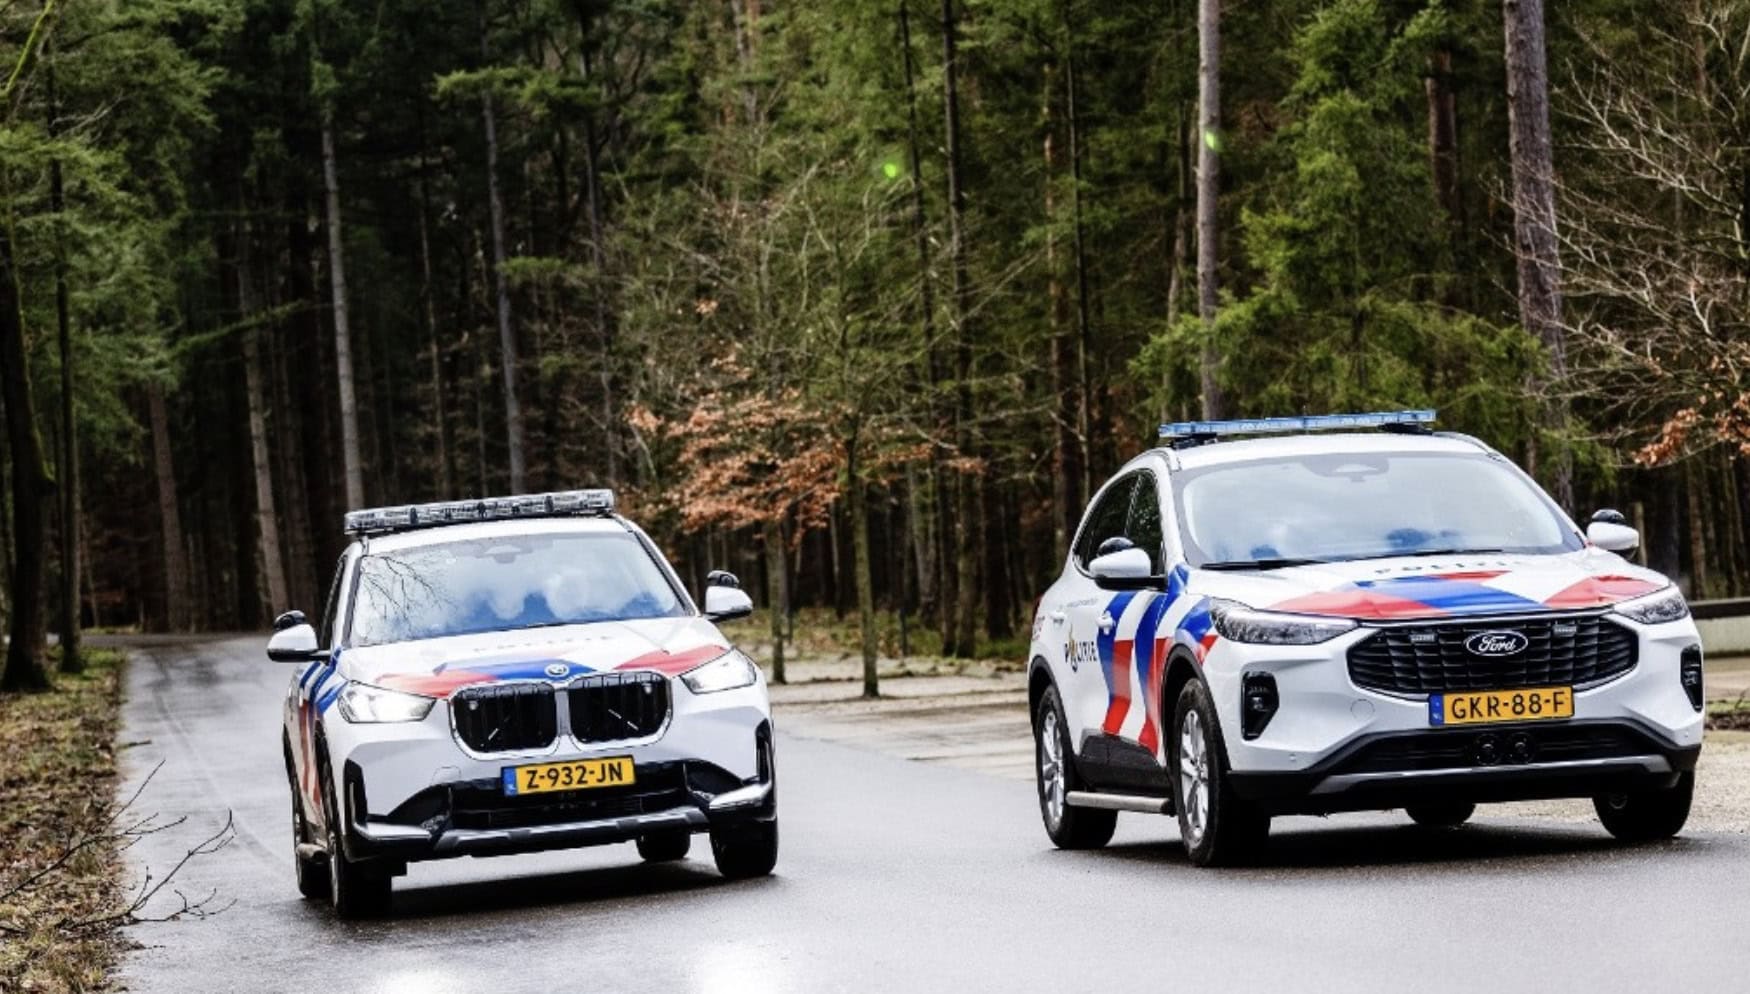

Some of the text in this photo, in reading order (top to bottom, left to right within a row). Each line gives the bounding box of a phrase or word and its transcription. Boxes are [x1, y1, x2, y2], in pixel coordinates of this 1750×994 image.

[1479, 635, 1516, 652] Ford
[1451, 691, 1565, 719] GKR-88-F
[526, 761, 623, 789] Z-932-JN
